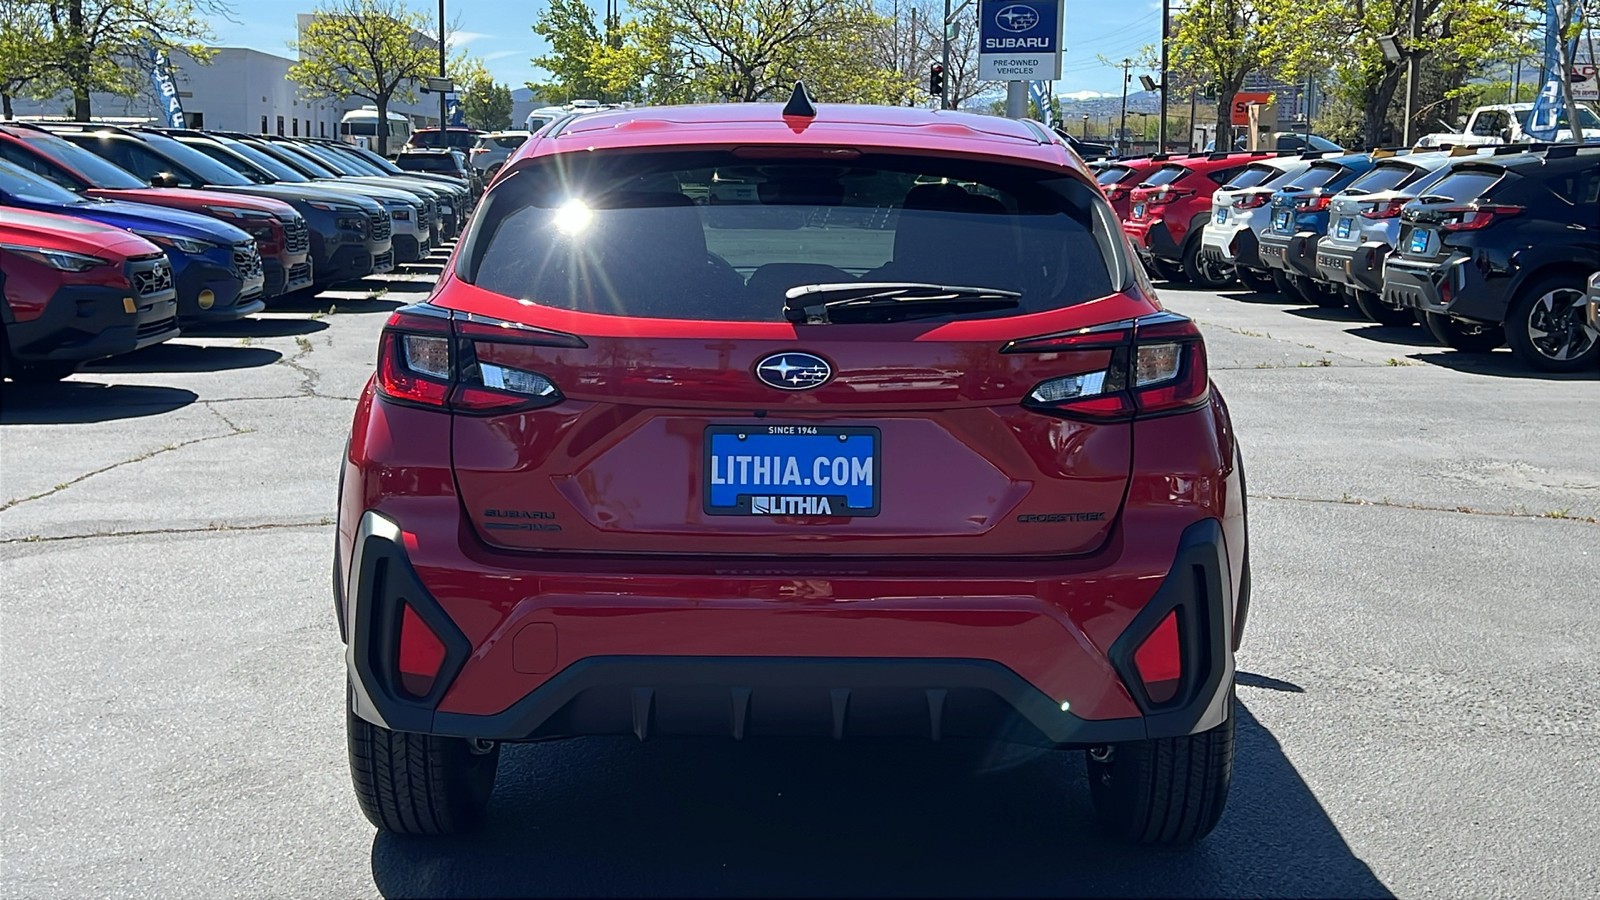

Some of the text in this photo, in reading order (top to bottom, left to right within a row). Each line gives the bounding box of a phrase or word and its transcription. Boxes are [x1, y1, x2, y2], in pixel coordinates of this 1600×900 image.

[985, 37, 1049, 49] SUBARU
[993, 59, 1039, 67] PRE-OWNED
[997, 67, 1034, 75] VEHICLES
[768, 426, 818, 435] SINCE 1946
[711, 455, 873, 487] LITHIA.COM
[769, 496, 832, 515] LITHIA
[484, 509, 556, 520] SUBARU
[1016, 511, 1107, 524] CROSSTREK
